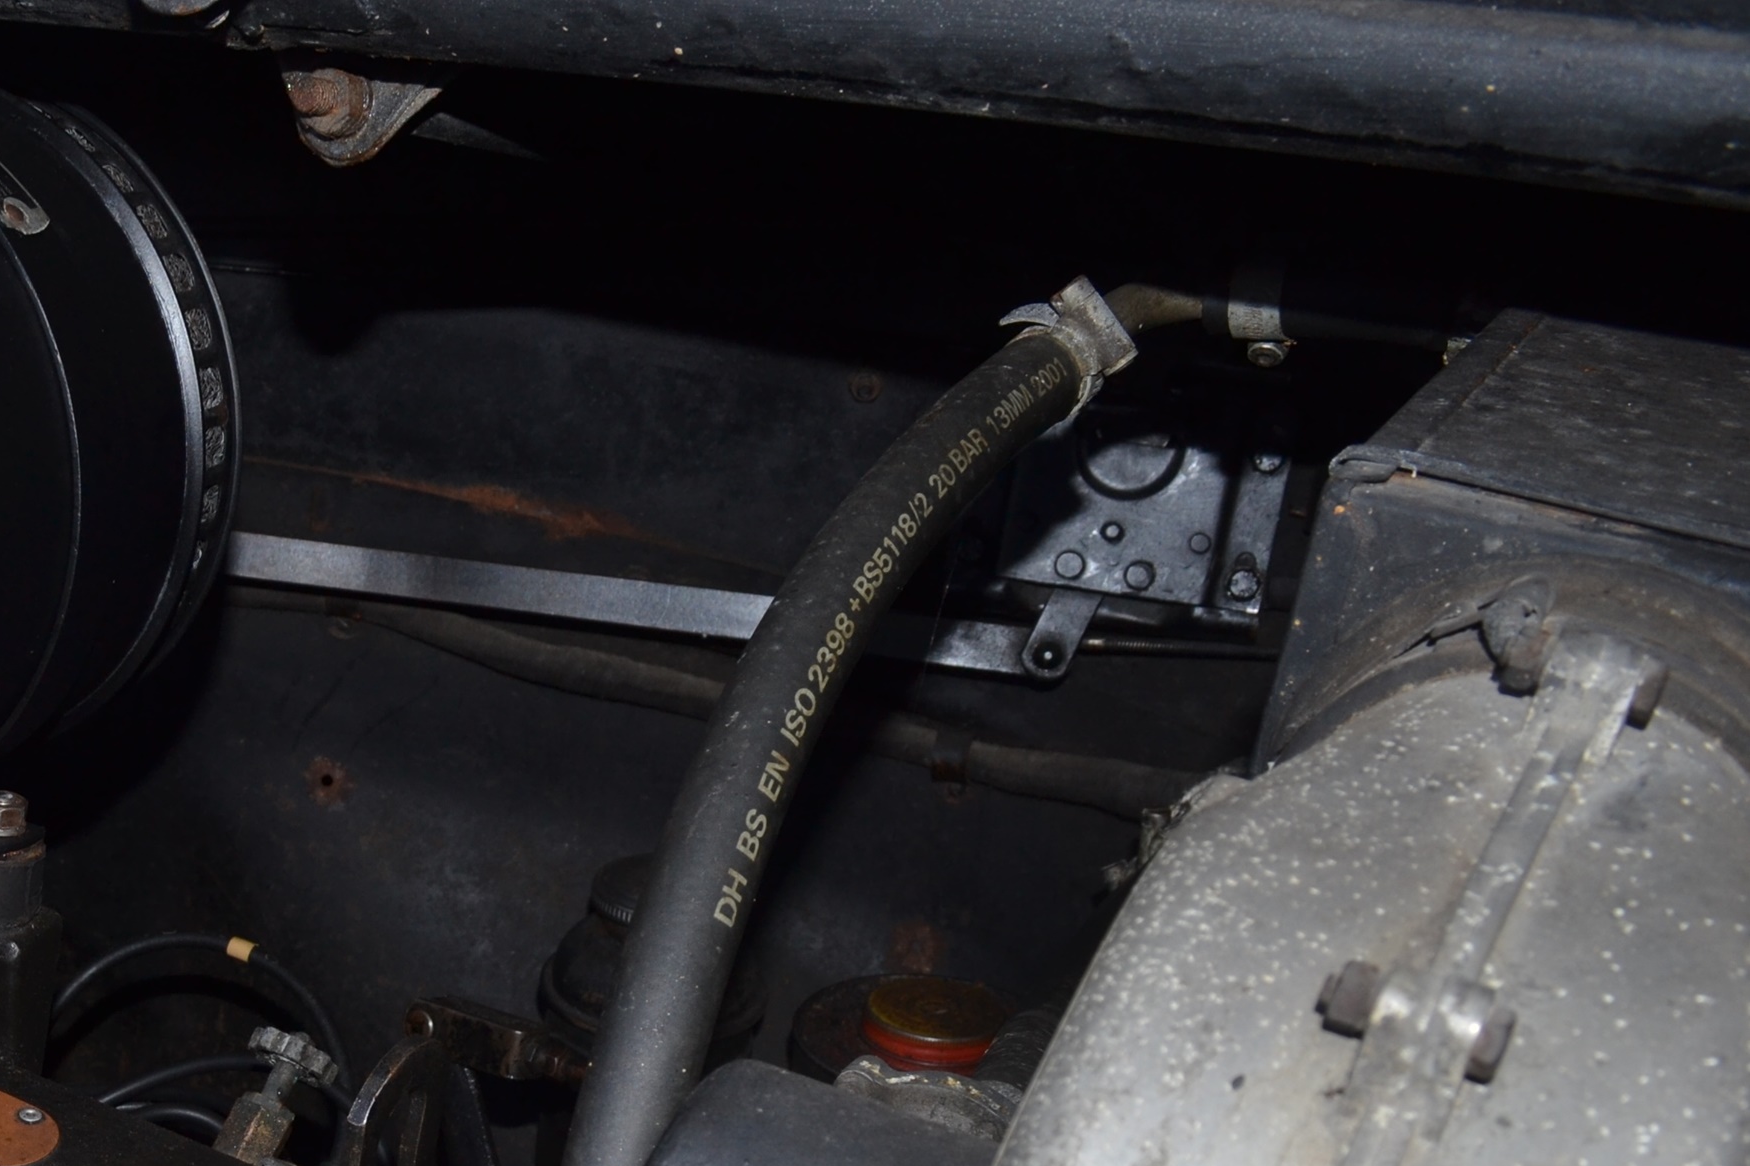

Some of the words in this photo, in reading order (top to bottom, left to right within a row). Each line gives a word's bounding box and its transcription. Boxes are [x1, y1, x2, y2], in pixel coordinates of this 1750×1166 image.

[713, 867, 748, 928] DH
[736, 808, 768, 862] BS
[757, 749, 791, 803] EN
[780, 687, 817, 747] ISO
[807, 612, 855, 693] 2398
[928, 463, 957, 500] 20
[949, 428, 989, 474] BAR
[985, 383, 1035, 436] 13MM
[1030, 357, 1068, 398] 2001
